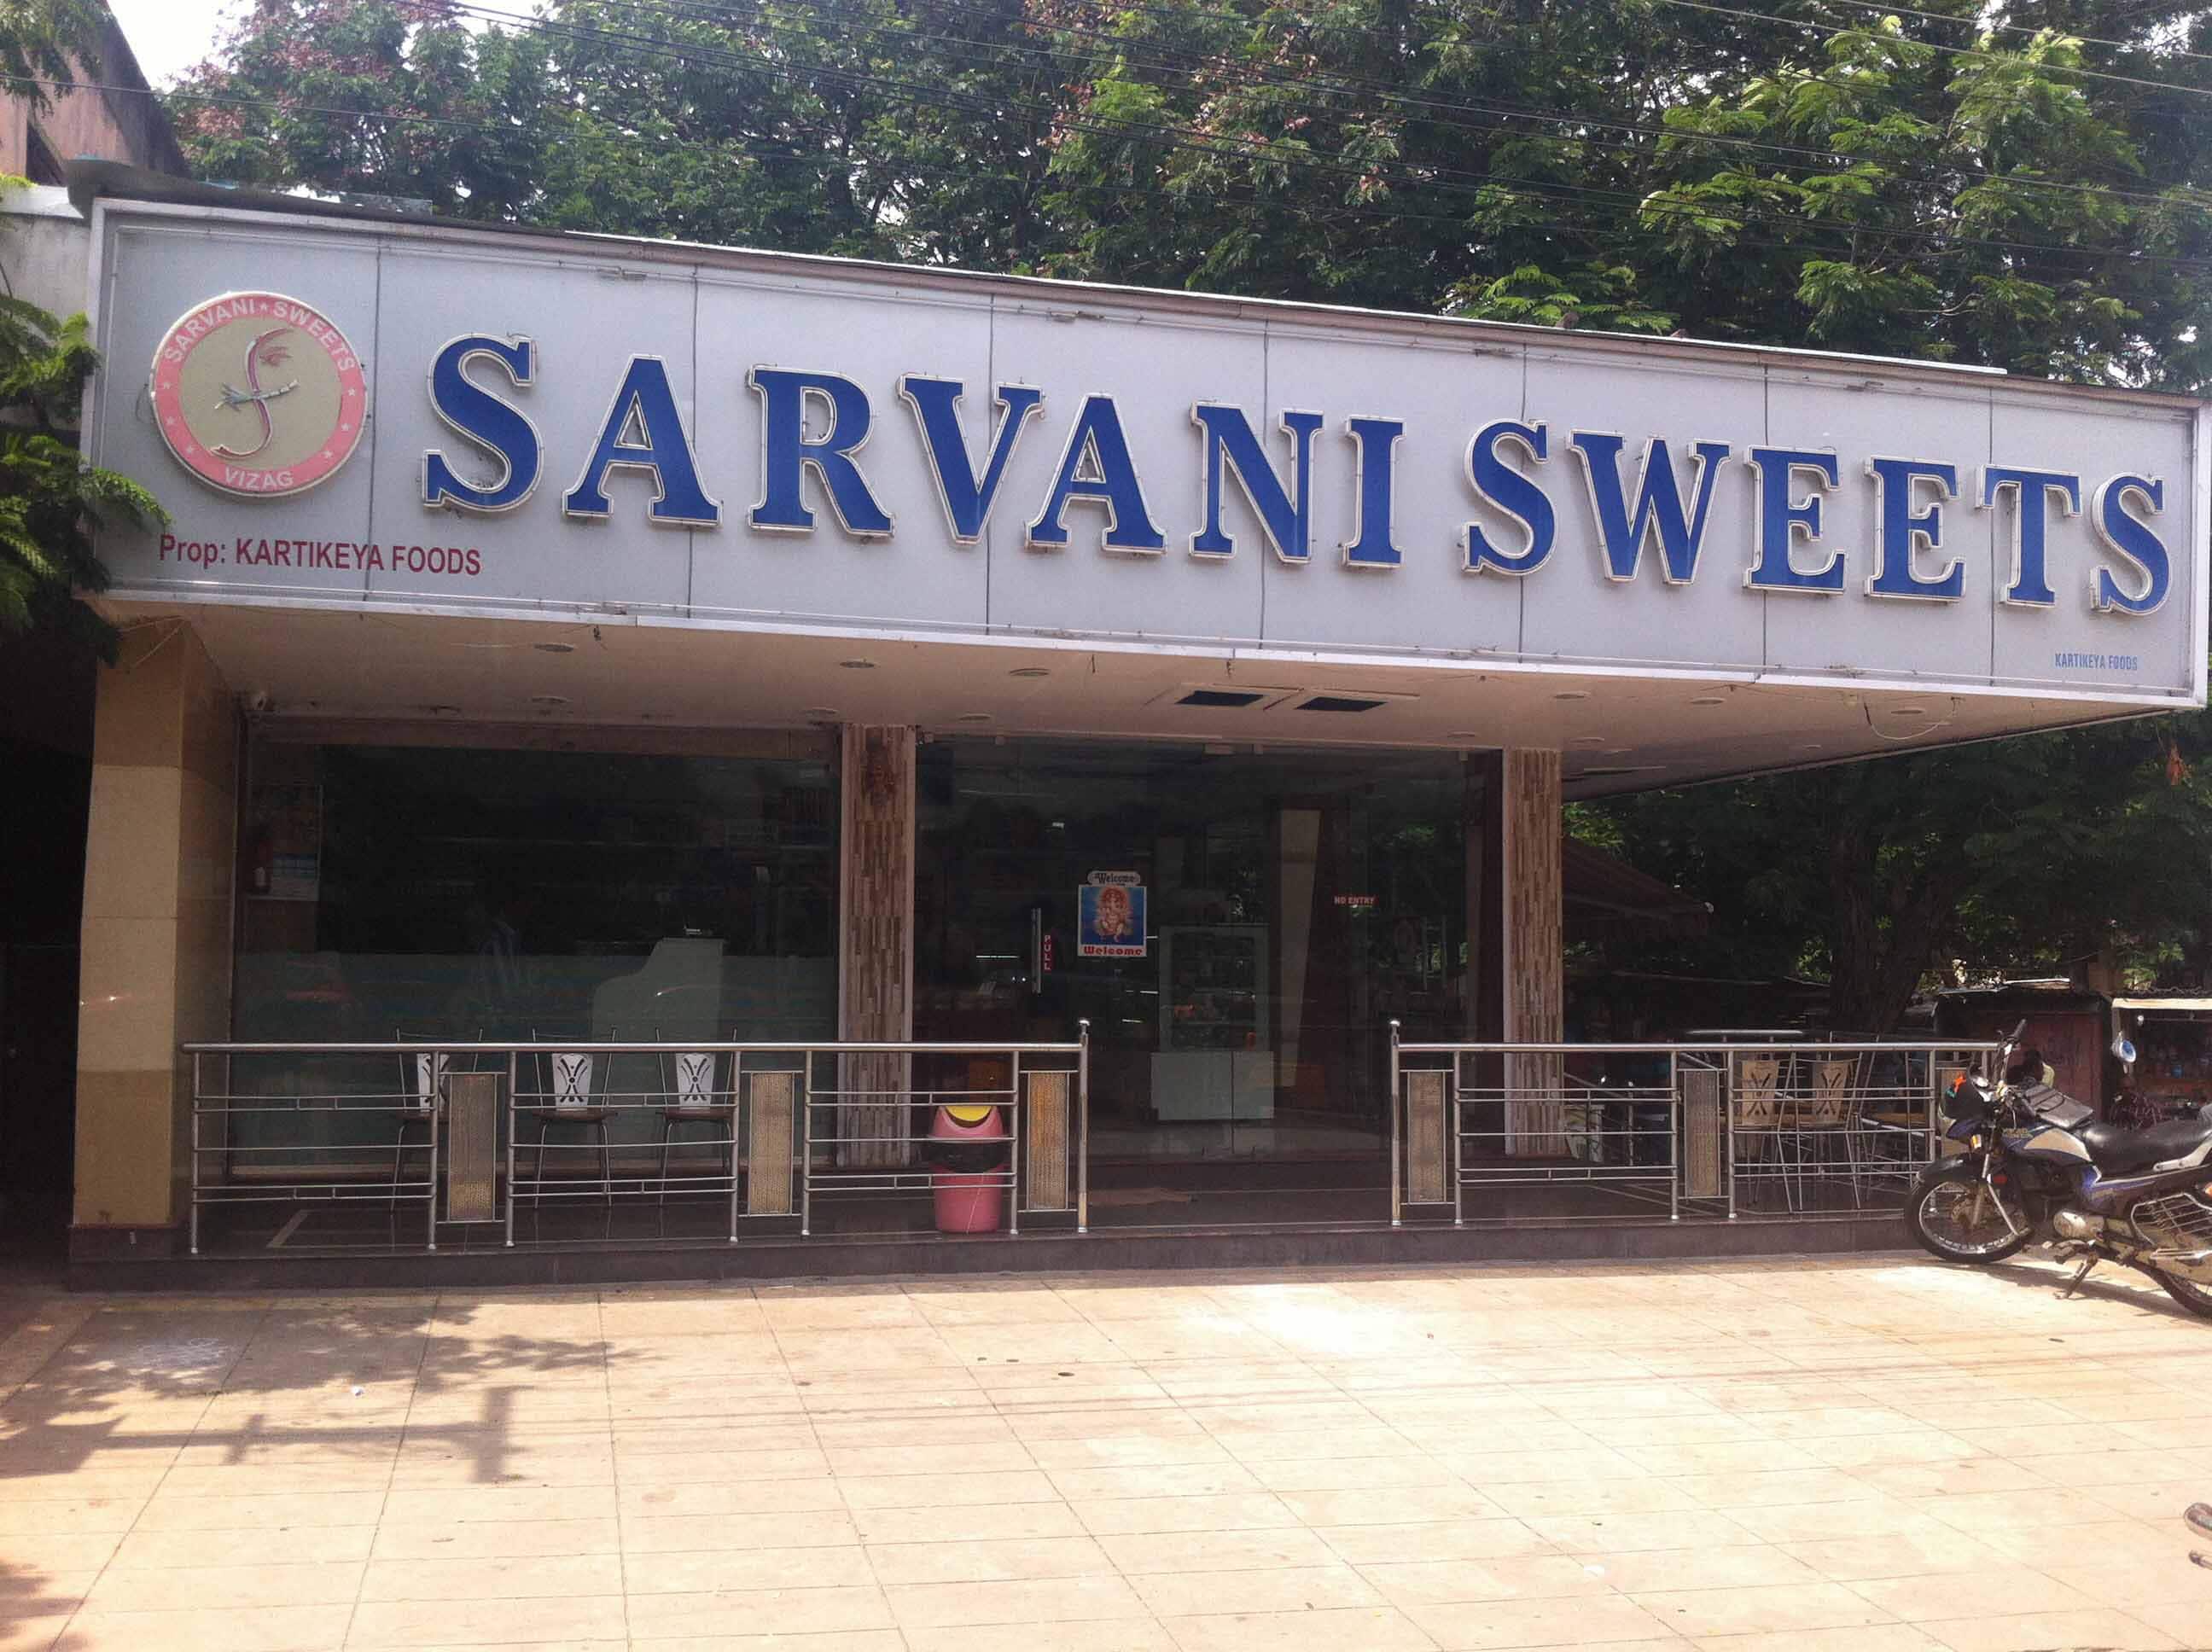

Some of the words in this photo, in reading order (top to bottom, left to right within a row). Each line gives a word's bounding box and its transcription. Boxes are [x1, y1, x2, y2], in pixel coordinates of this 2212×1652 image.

[163, 298, 256, 364] SARVANI
[272, 301, 355, 371] SWEETS
[224, 467, 294, 490] VIZAG
[422, 333, 1407, 567] SARVANI
[1462, 418, 2172, 616] SWEETS
[159, 534, 227, 569] Prop:
[236, 538, 385, 571] KARTIKEYA
[392, 545, 480, 575] FOODS
[2054, 653, 2106, 669] KARTIKEYA
[2109, 655, 2138, 671] FOODS
[1083, 945, 1143, 956] Welcome
